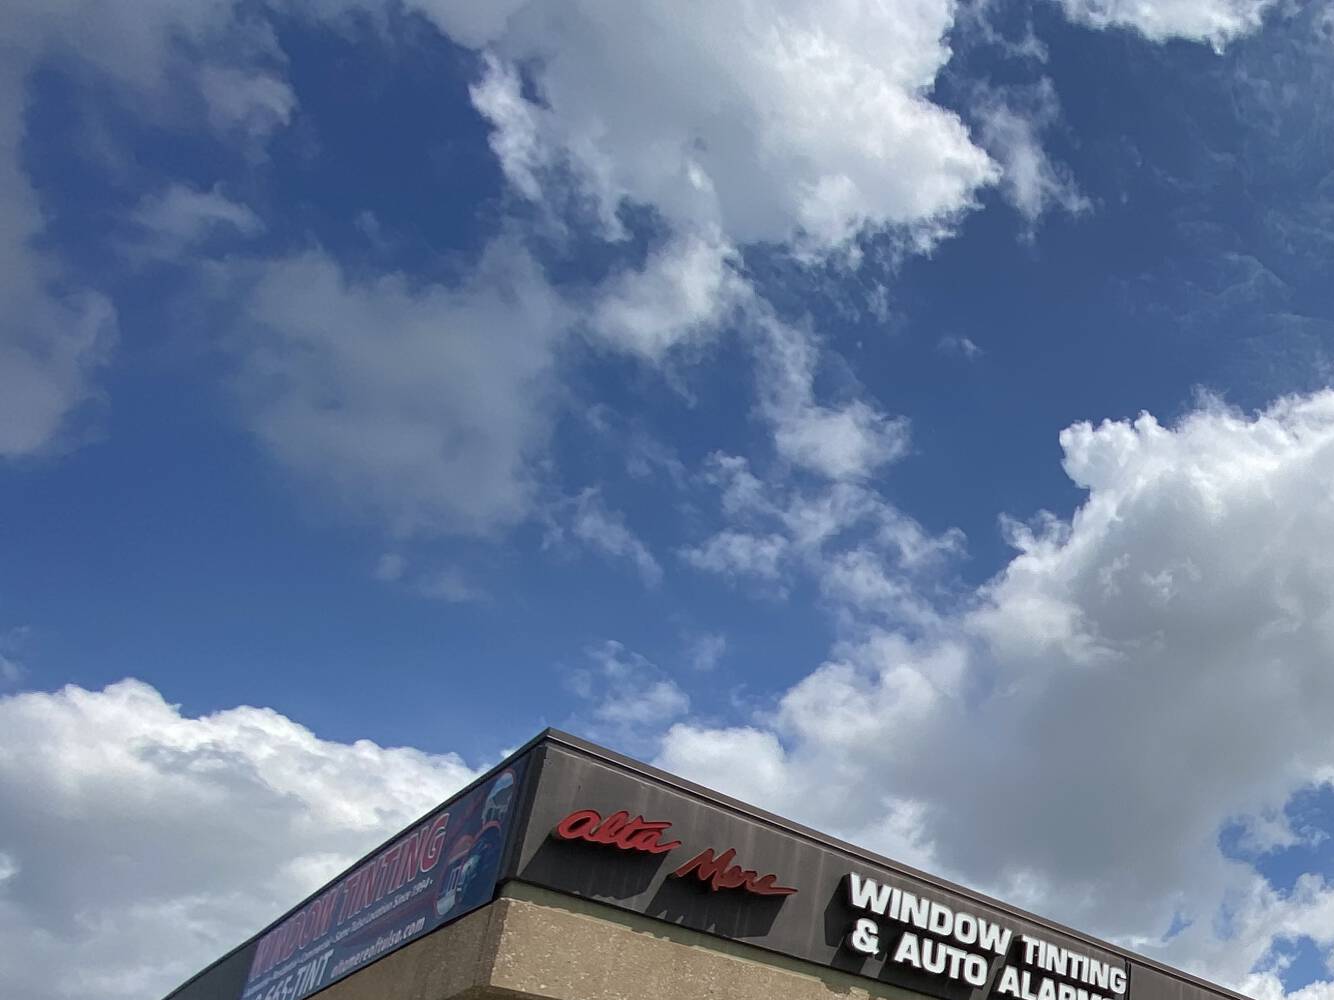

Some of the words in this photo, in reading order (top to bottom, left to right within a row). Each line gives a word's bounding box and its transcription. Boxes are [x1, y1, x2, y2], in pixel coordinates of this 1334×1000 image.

[248, 881, 345, 983] WINDOW
[337, 813, 450, 926] TINTING
[557, 809, 683, 854] Alta
[674, 848, 798, 895] Mere
[848, 871, 1012, 956] WINDOW
[1021, 933, 1127, 995] TINTING
[850, 919, 880, 955] &
[894, 934, 988, 987] AUTO
